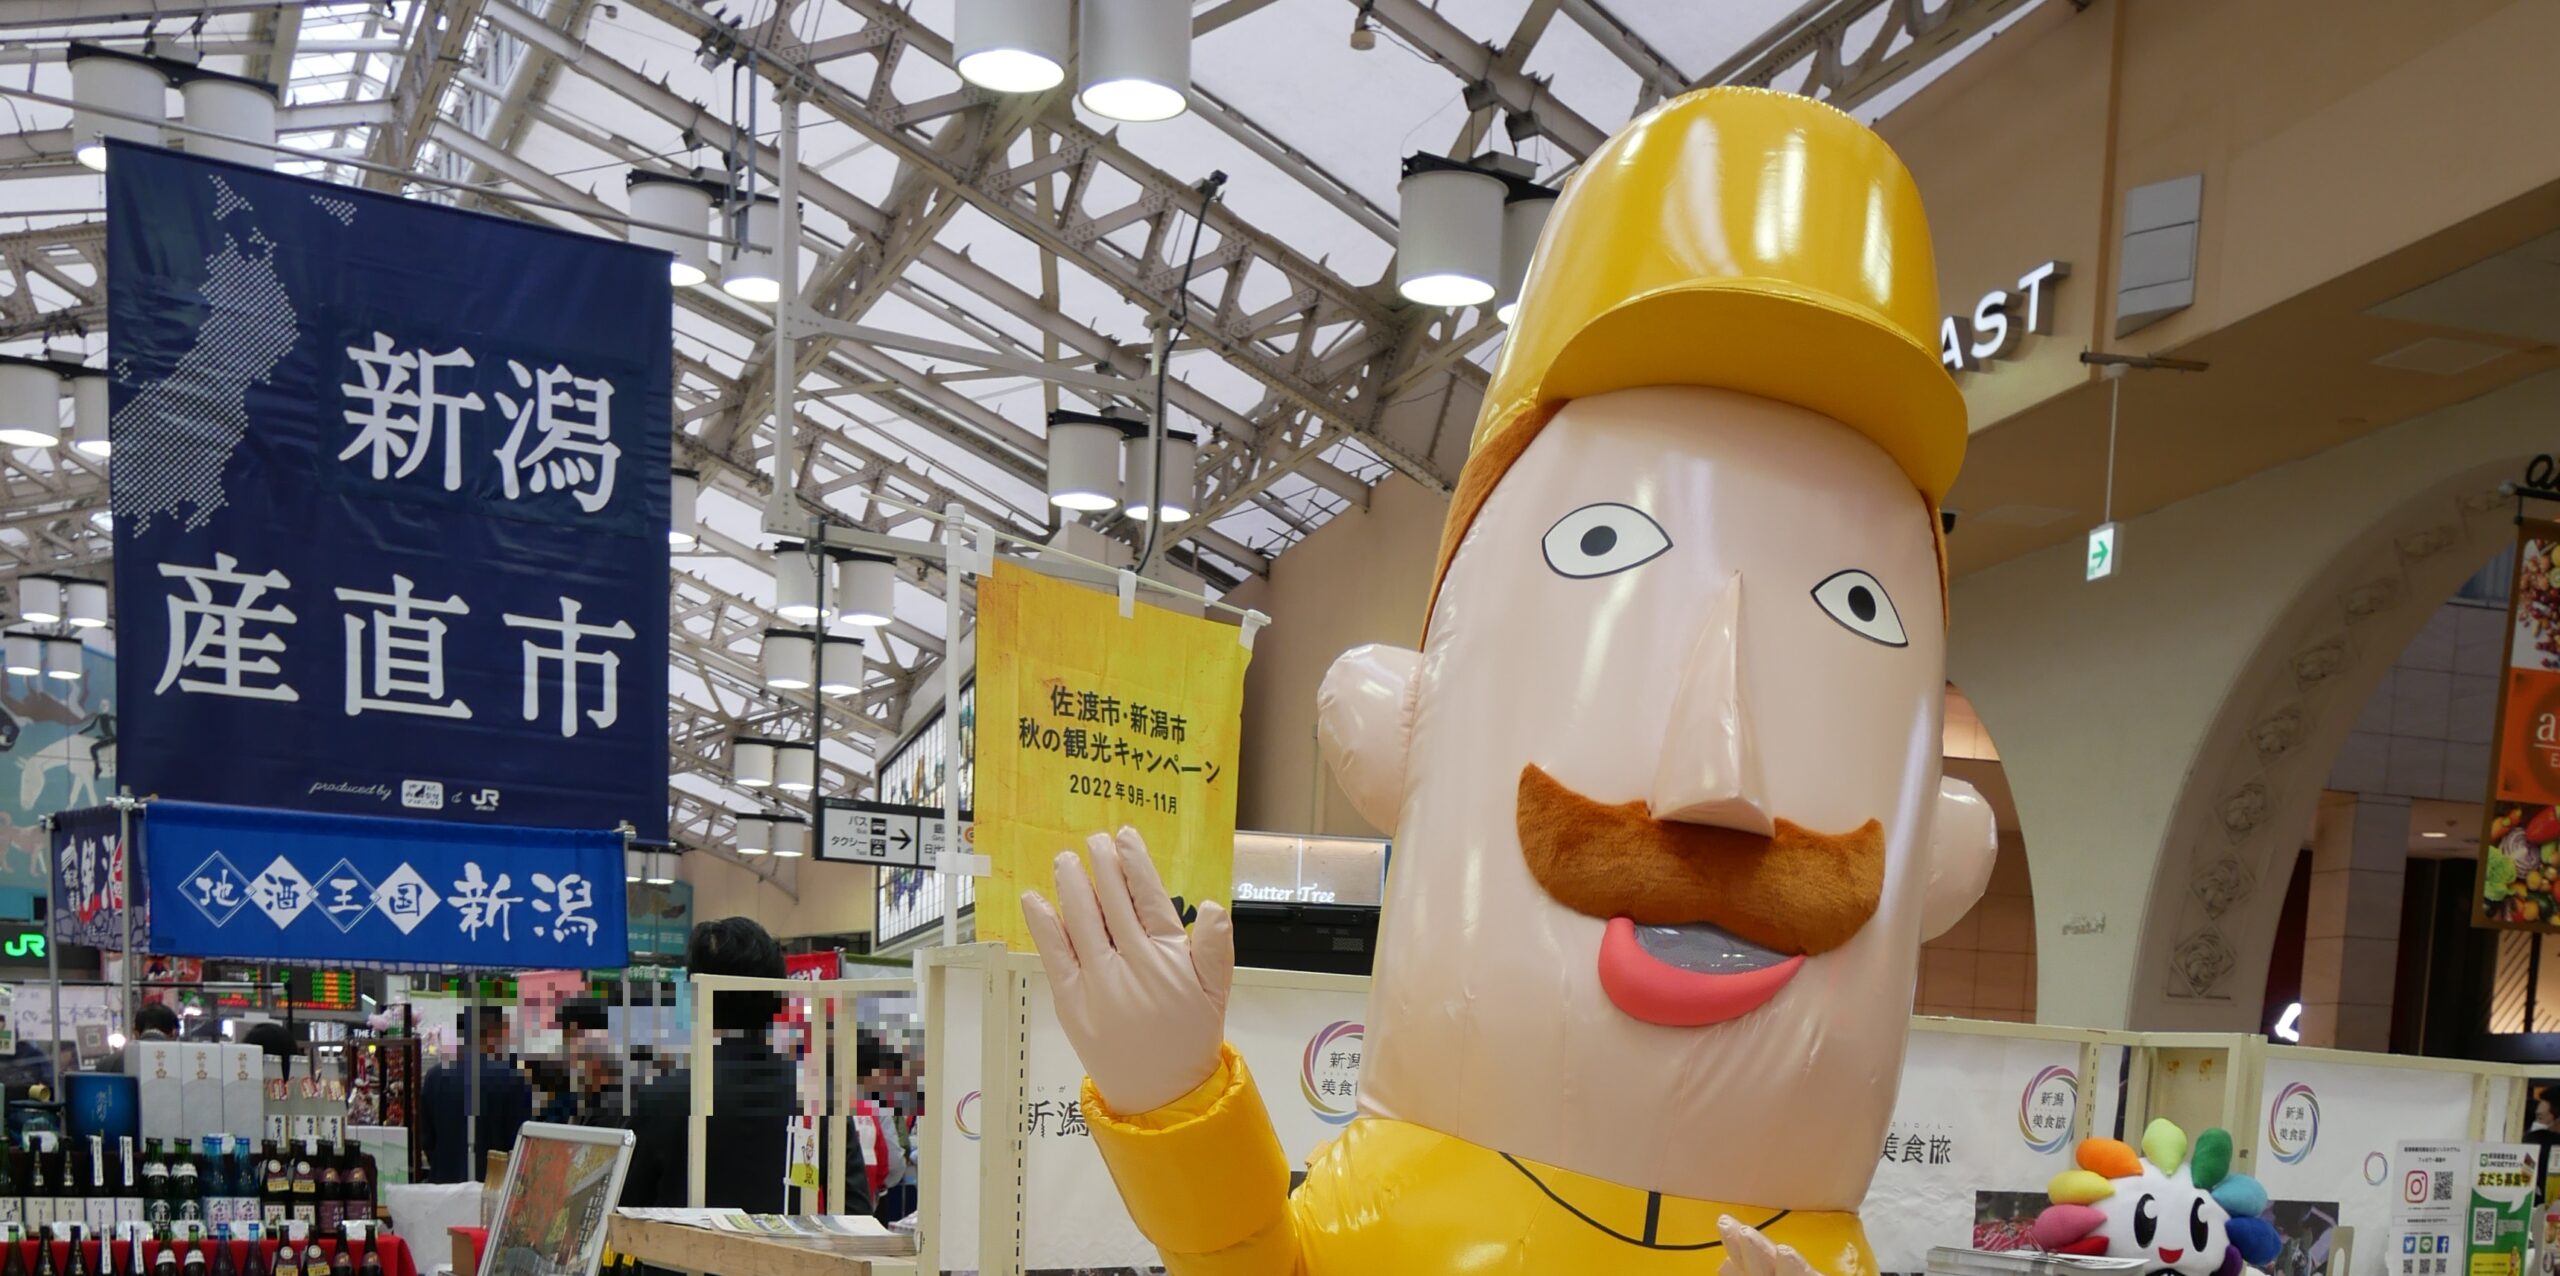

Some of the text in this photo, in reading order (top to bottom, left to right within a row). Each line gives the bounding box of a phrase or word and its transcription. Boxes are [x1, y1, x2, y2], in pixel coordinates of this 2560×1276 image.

[338, 331, 621, 513] 新潟
[154, 552, 636, 738] 産直市
[1018, 717, 1220, 784] 秋の観光キャンペーン
[308, 781, 376, 795] produced
[376, 784, 392, 801] by
[848, 815, 868, 826] バス
[830, 835, 868, 847] タクシー
[195, 869, 422, 918] 地酒王国
[447, 861, 599, 946] 新潟
[1238, 882, 1335, 903] Butter Tree
[5, 933, 46, 958] JR
[1321, 1079, 1359, 1097] 美食
